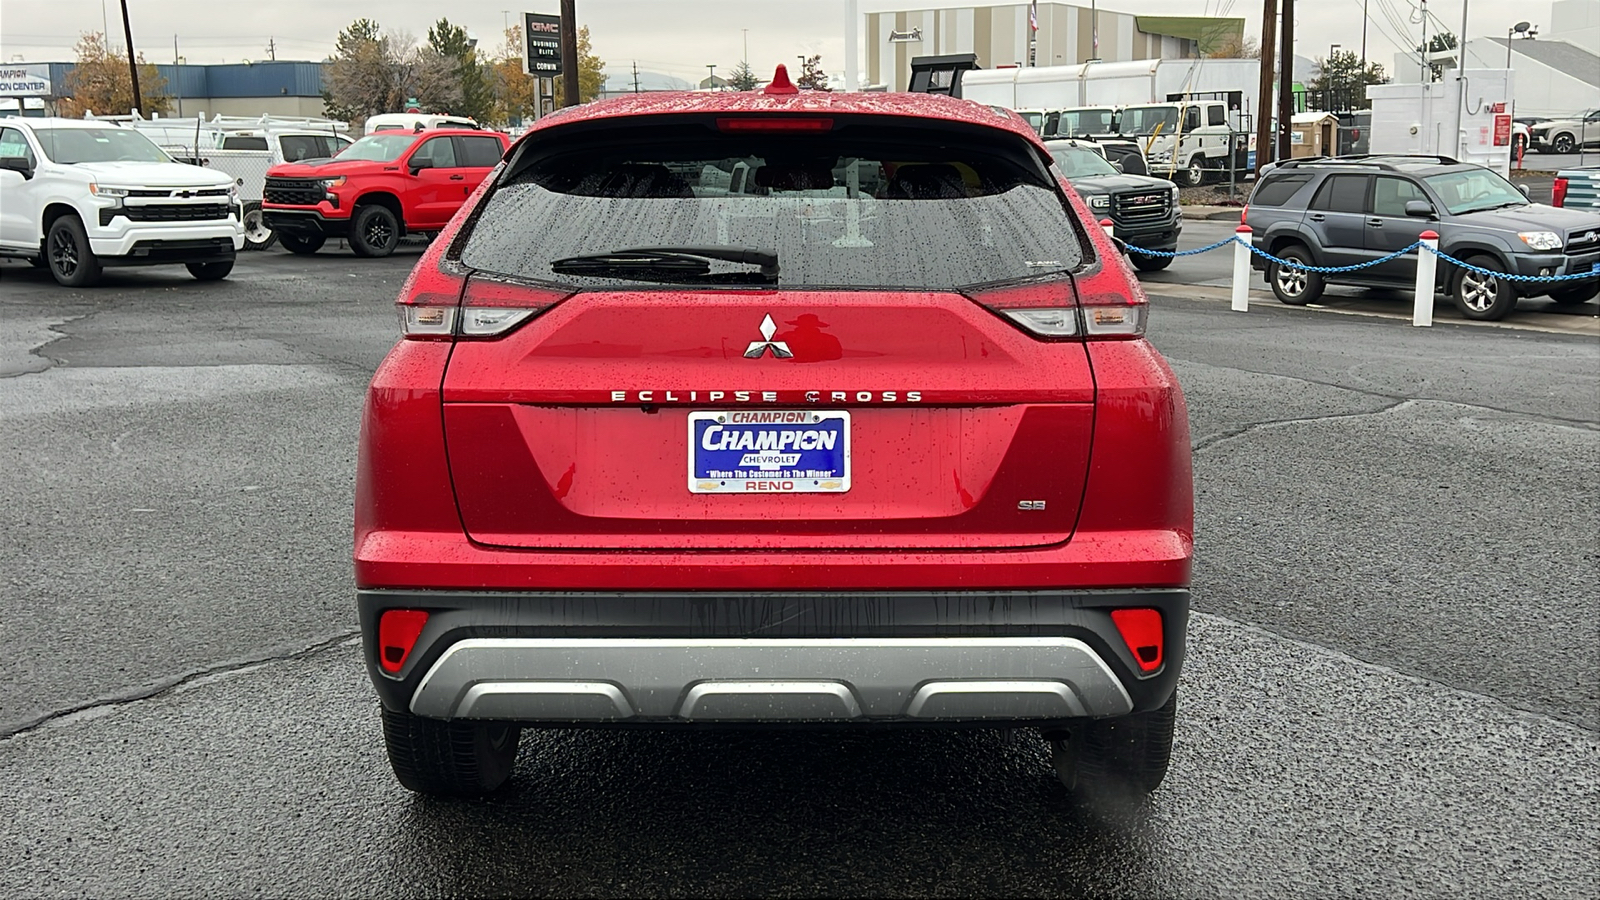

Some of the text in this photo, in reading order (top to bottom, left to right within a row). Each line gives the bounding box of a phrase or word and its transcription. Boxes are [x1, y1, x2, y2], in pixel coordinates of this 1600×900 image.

[531, 22, 559, 33] GMC
[533, 40, 559, 48] BUSINESS
[538, 48, 554, 56] ELITE
[536, 62, 557, 71] CORWIN
[13, 82, 45, 91] CENTER
[611, 391, 922, 402] ECLIPSE CROSS
[732, 412, 807, 423] CHAMPION
[702, 425, 838, 451] CHAMPION
[743, 455, 796, 464] CHEVROLET
[734, 470, 748, 478] The
[748, 470, 783, 478] Customer
[792, 470, 806, 478] The
[745, 481, 794, 491] RENO
[1017, 500, 1046, 510] SE
